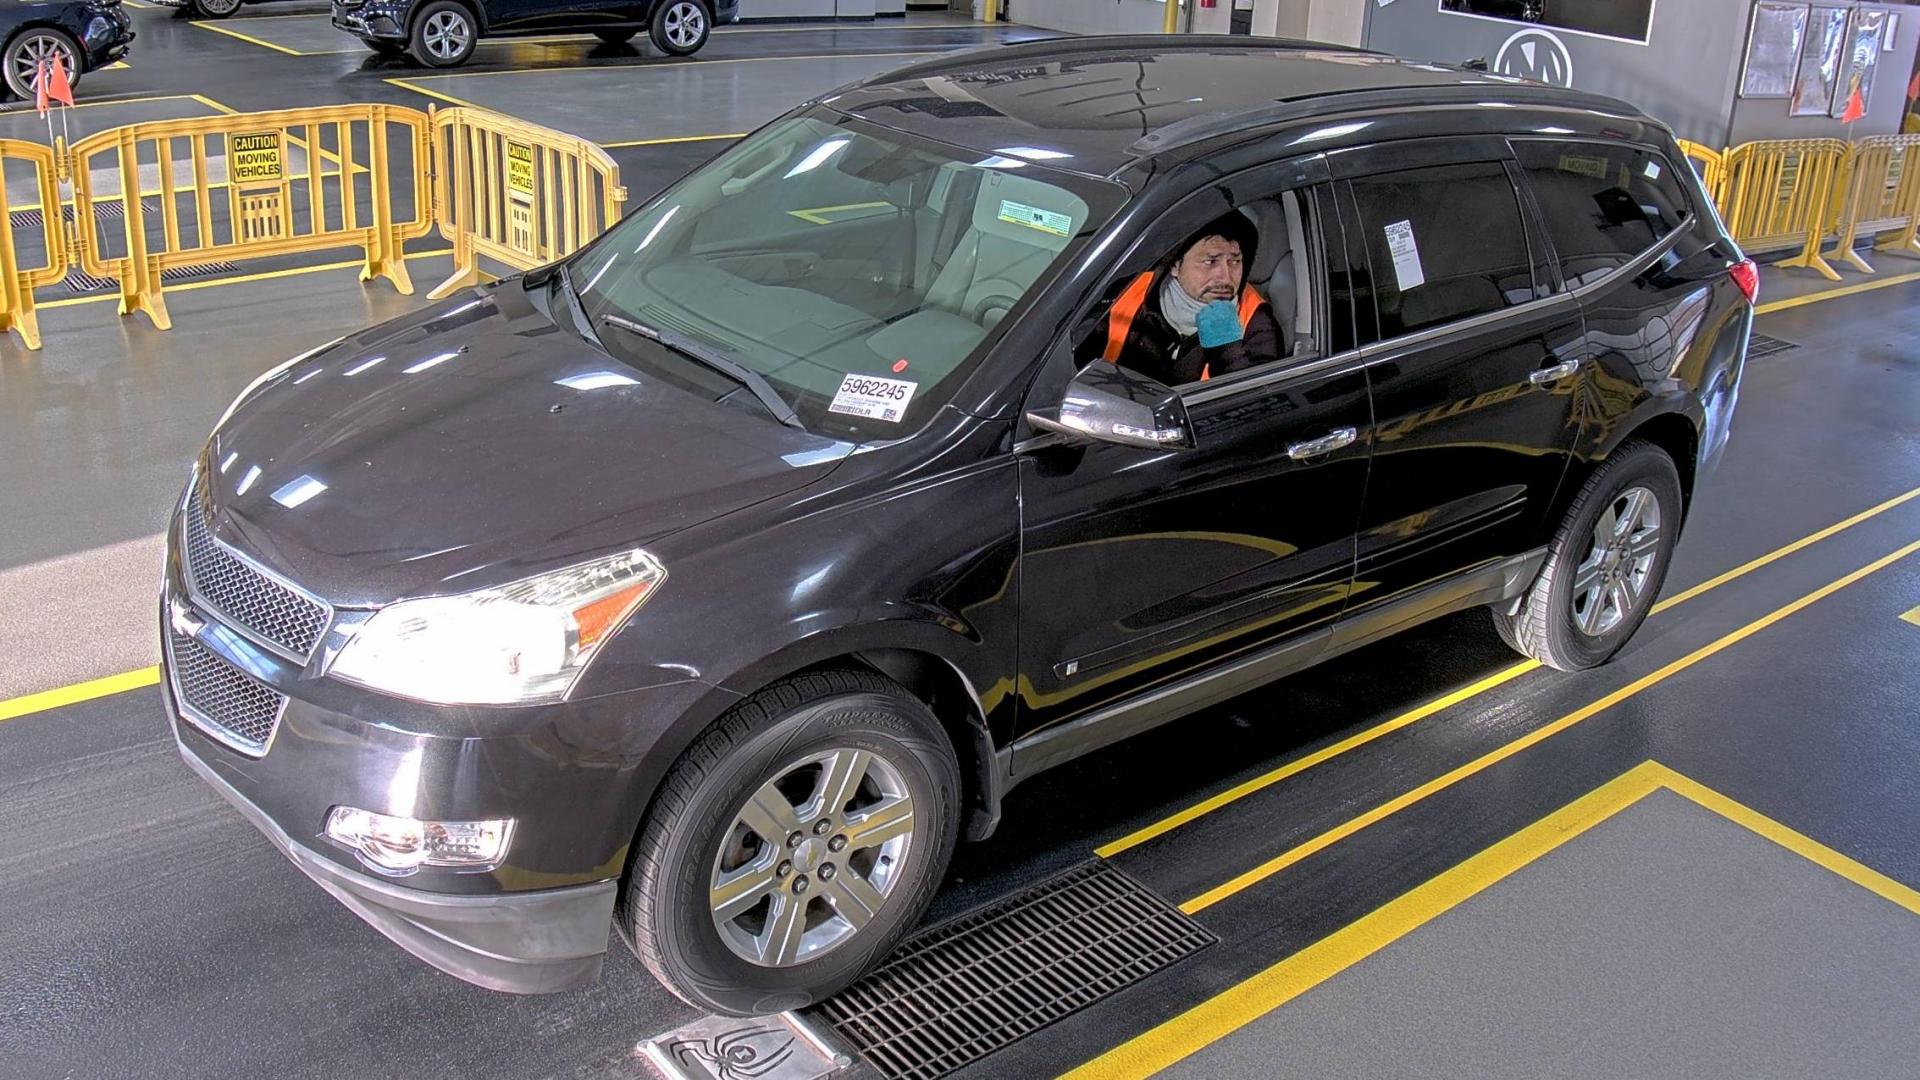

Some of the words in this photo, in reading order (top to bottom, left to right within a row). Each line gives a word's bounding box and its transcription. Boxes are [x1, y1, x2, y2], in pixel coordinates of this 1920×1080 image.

[234, 135, 278, 150] CAUTION
[237, 152, 277, 165] MOVING
[508, 142, 531, 161] CAUTION
[235, 163, 280, 178] VEHICLES
[510, 160, 531, 177] MOVING
[841, 378, 907, 401] 5962245
